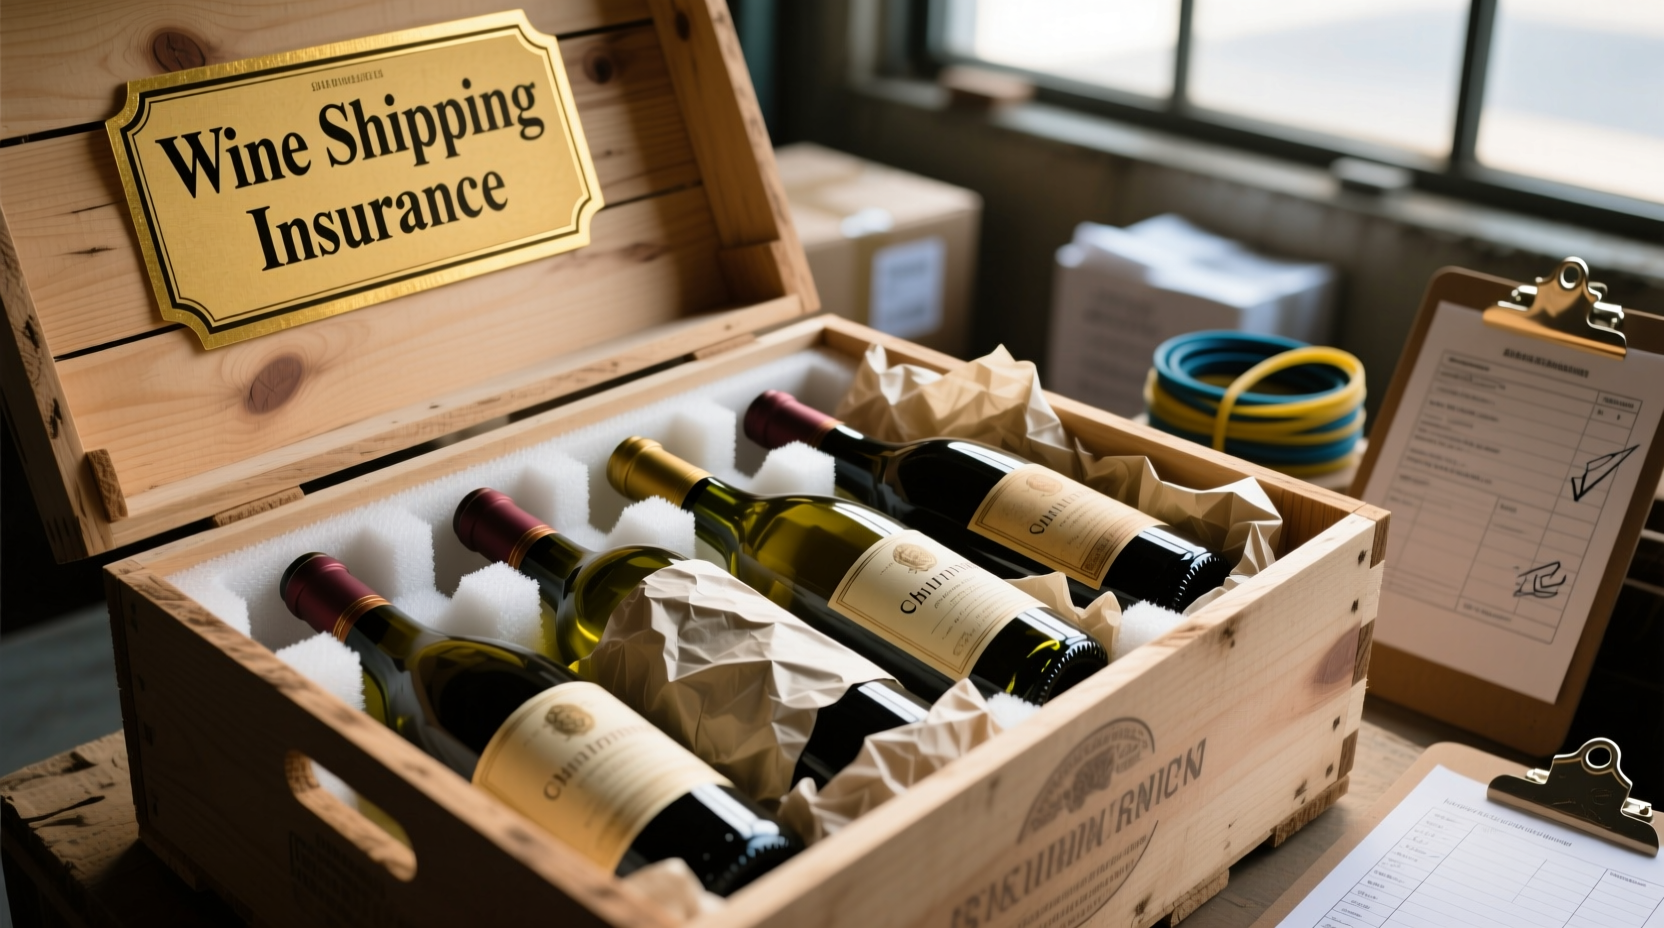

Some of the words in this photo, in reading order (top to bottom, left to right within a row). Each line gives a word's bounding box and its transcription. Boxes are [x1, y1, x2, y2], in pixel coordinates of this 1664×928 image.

[155, 126, 312, 199] Wine
[318, 78, 545, 168] Shipping
[246, 171, 508, 272] Insurance
